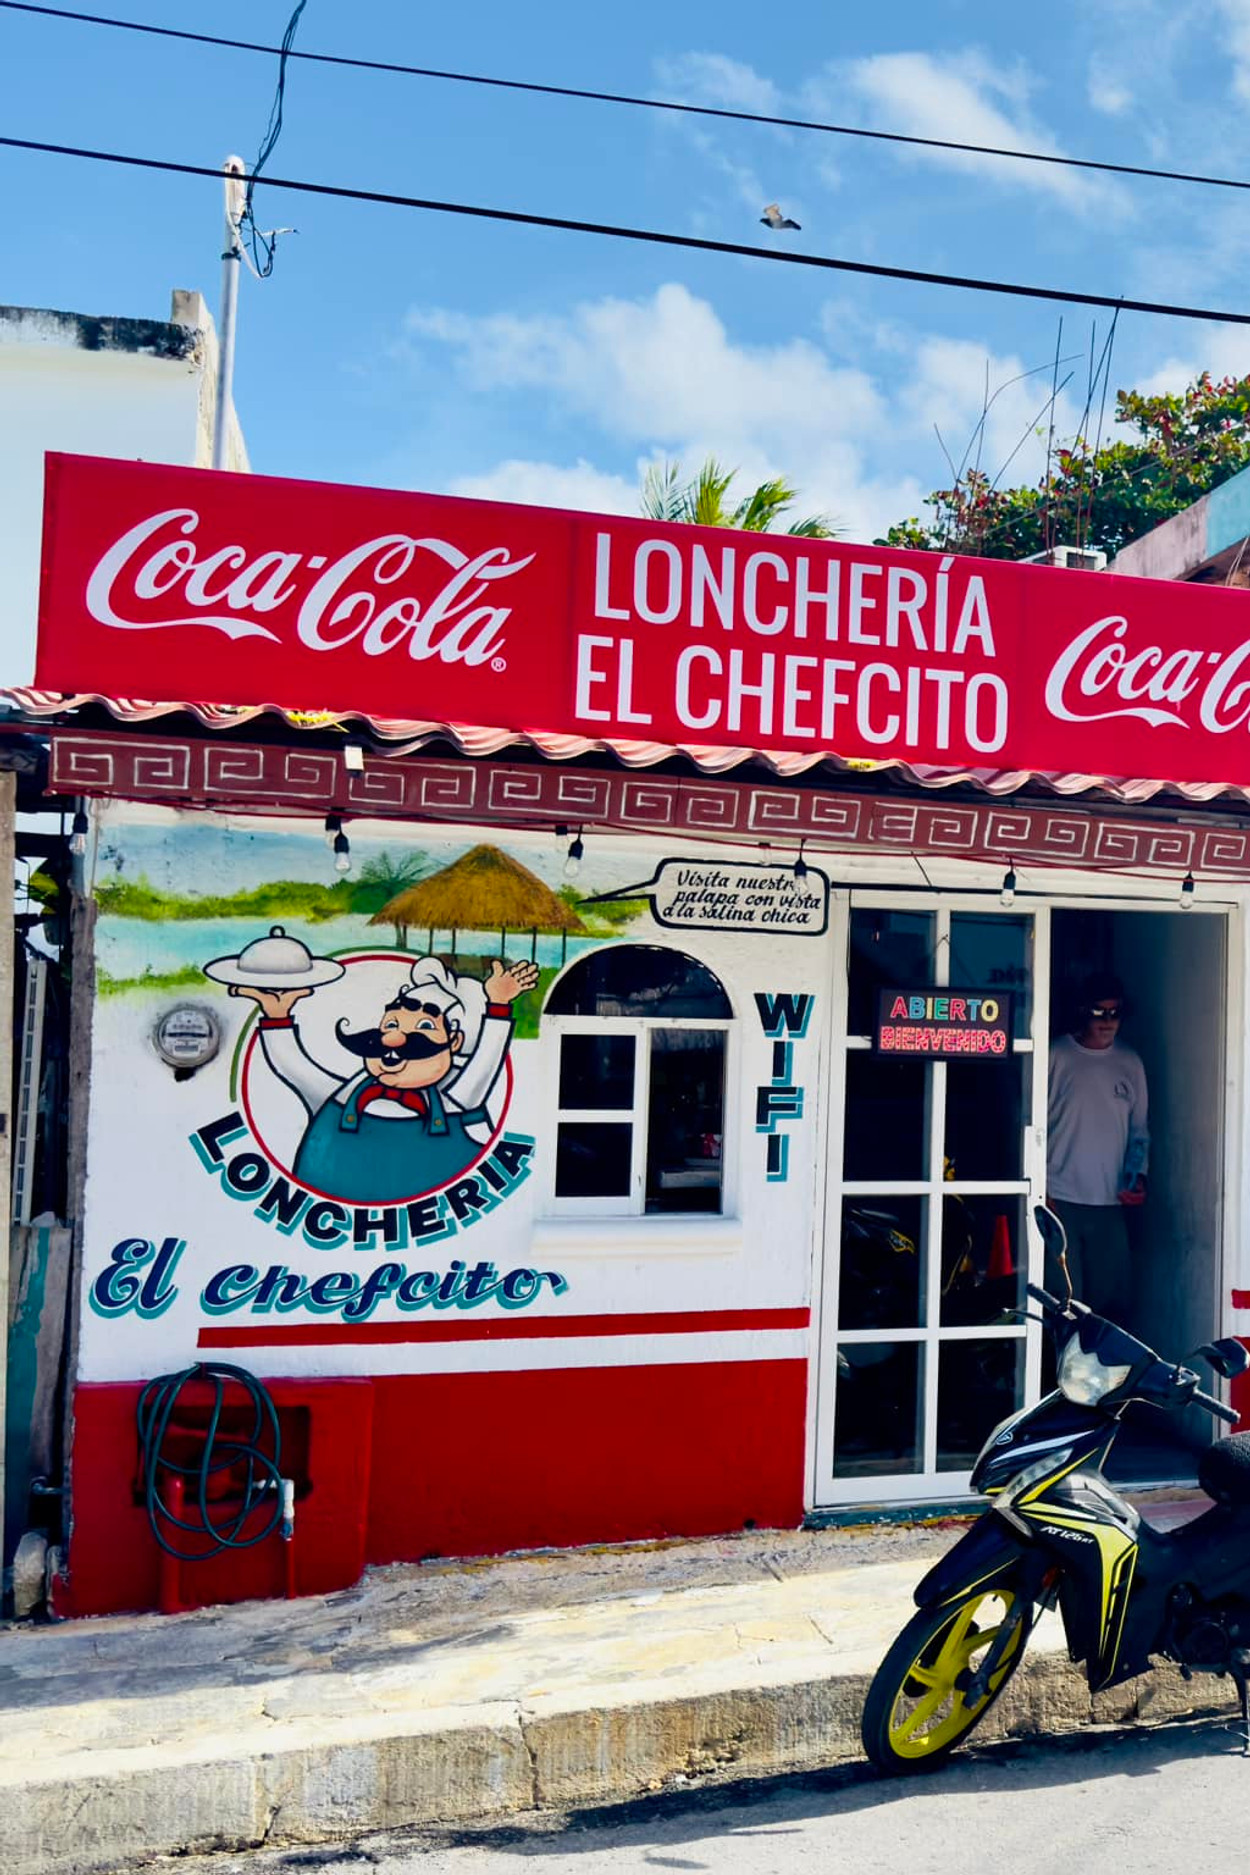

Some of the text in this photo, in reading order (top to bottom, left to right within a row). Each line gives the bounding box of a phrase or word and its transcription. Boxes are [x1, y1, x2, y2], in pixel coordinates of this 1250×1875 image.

[86, 508, 536, 667] Coca-Cola
[594, 532, 996, 657] LONCHERÍA
[575, 634, 1009, 754] EL CHEFCITO
[662, 903, 811, 924] a la salina chica
[672, 888, 822, 910] palapa con vista
[677, 869, 806, 893] Visita nuestr
[880, 1025, 1007, 1054] BIENVENIDO
[890, 996, 999, 1022] ABIERTO
[753, 993, 816, 1183] WIFI
[188, 1110, 537, 1252] LONCHERIA
[88, 1237, 188, 1320] El
